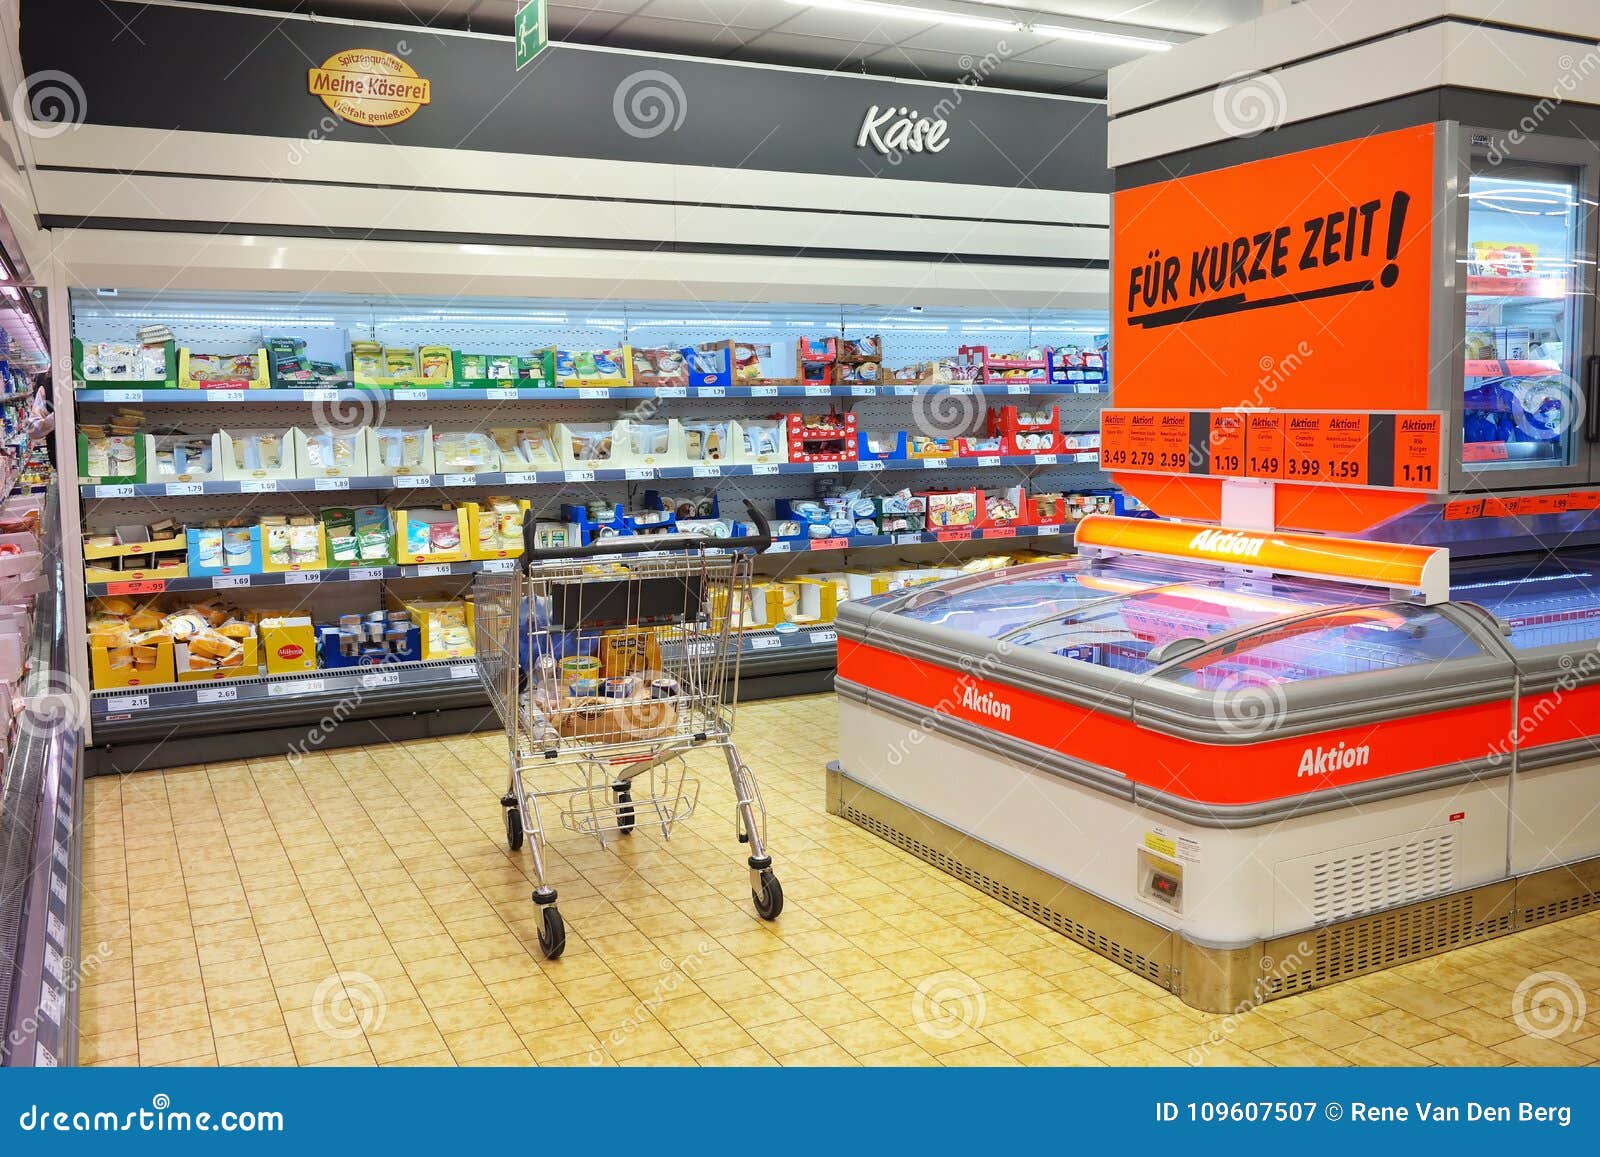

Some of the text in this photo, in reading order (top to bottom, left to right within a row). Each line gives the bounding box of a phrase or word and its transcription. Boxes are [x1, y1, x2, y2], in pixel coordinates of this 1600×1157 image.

[338, 54, 403, 73] Spitzenqualität
[313, 73, 427, 100] Meine Käserei
[333, 100, 411, 123] Vielfalt genießen
[857, 104, 951, 155] Käse
[1128, 190, 1411, 313] FÜR KURZE ZEIT!
[1105, 415, 1126, 425] Aktion!
[1132, 415, 1154, 425] Aktion!
[1161, 415, 1185, 426] Aktion!
[1252, 417, 1279, 429] Aktion!
[1290, 418, 1320, 429] Aktion!
[1329, 419, 1360, 430] Aktion!
[1401, 420, 1436, 432] Aktion!
[1104, 450, 1126, 464] 3.49
[1131, 451, 1154, 466] 2.79
[1160, 453, 1186, 468] 2.99
[1215, 455, 1239, 471] 1.19
[1251, 457, 1279, 473] 1.49
[1289, 458, 1320, 475] 3.99
[1328, 460, 1359, 477] 1.59
[1402, 464, 1432, 482] 1.11
[118, 487, 133, 495] 1.79
[1189, 529, 1264, 557] Aktion
[146, 583, 163, 592] -.99
[962, 686, 1011, 723] Aktion
[1297, 742, 1370, 778] Aktion
